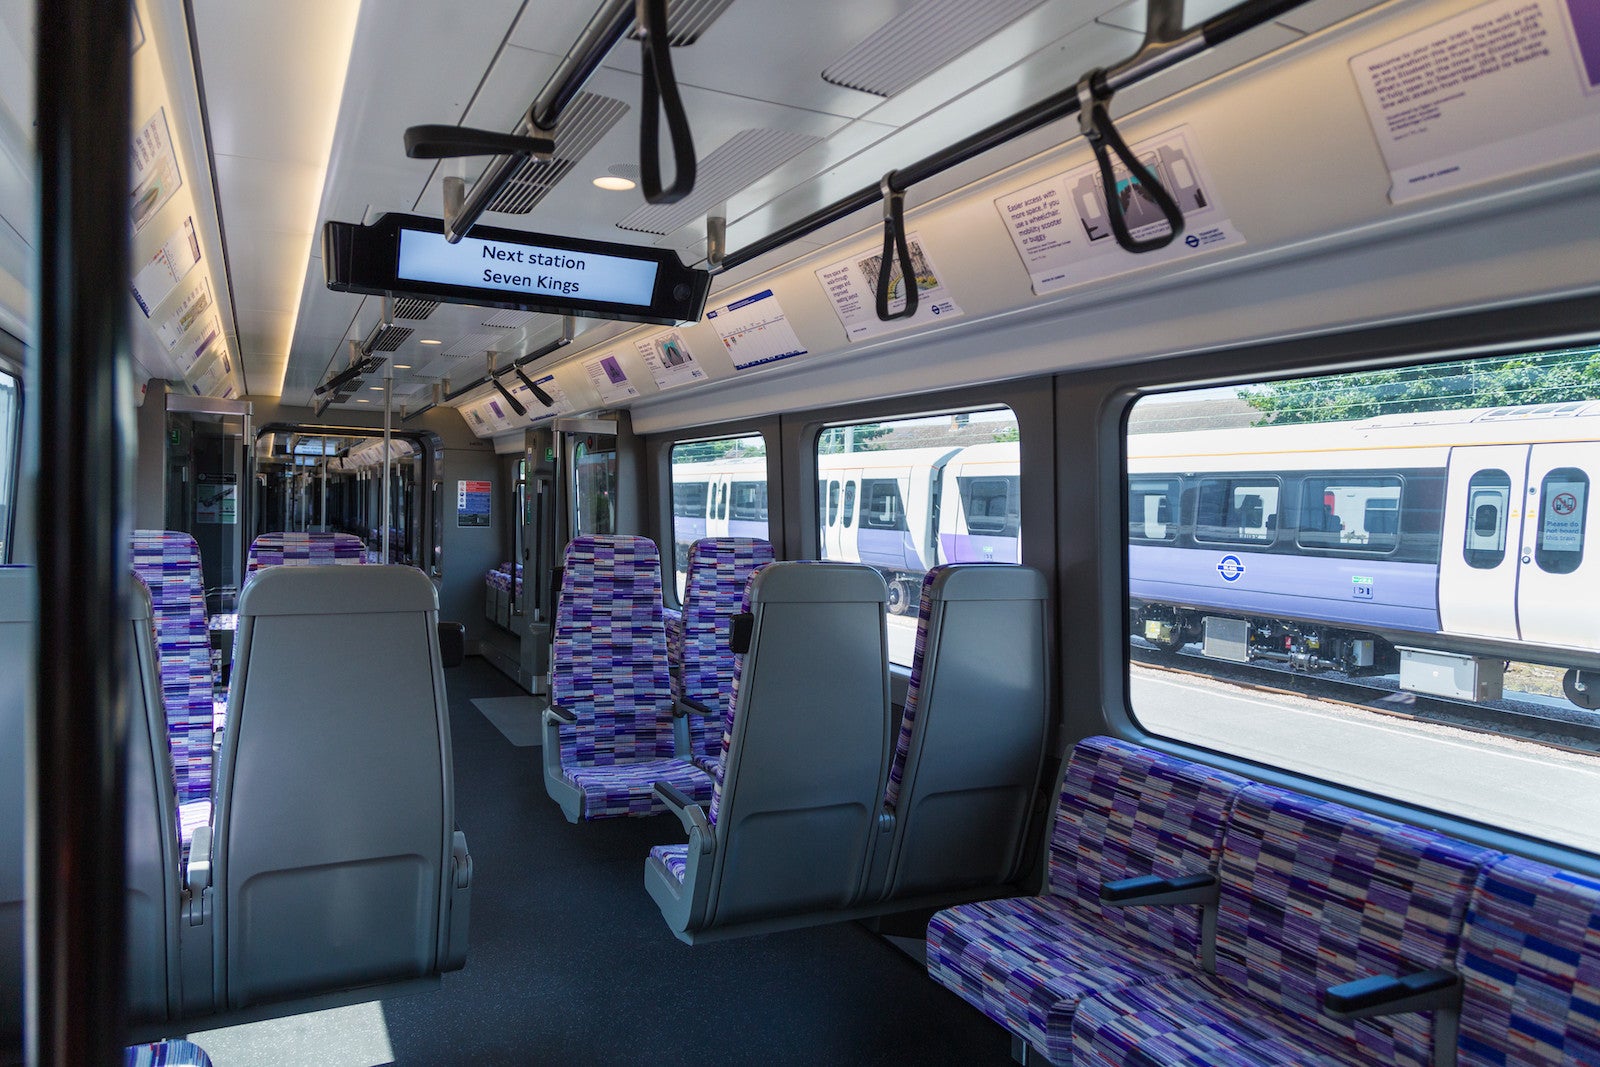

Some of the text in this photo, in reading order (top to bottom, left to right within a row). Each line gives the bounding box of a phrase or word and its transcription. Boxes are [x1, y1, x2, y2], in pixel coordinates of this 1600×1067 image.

[1007, 190, 1057, 212] Easier access with
[1011, 211, 1025, 220] more
[1048, 199, 1060, 209] you
[1015, 221, 1025, 229] use
[1019, 218, 1062, 236] mobility scooter
[482, 245, 585, 270] Next station
[482, 269, 580, 294] Seven Kings
